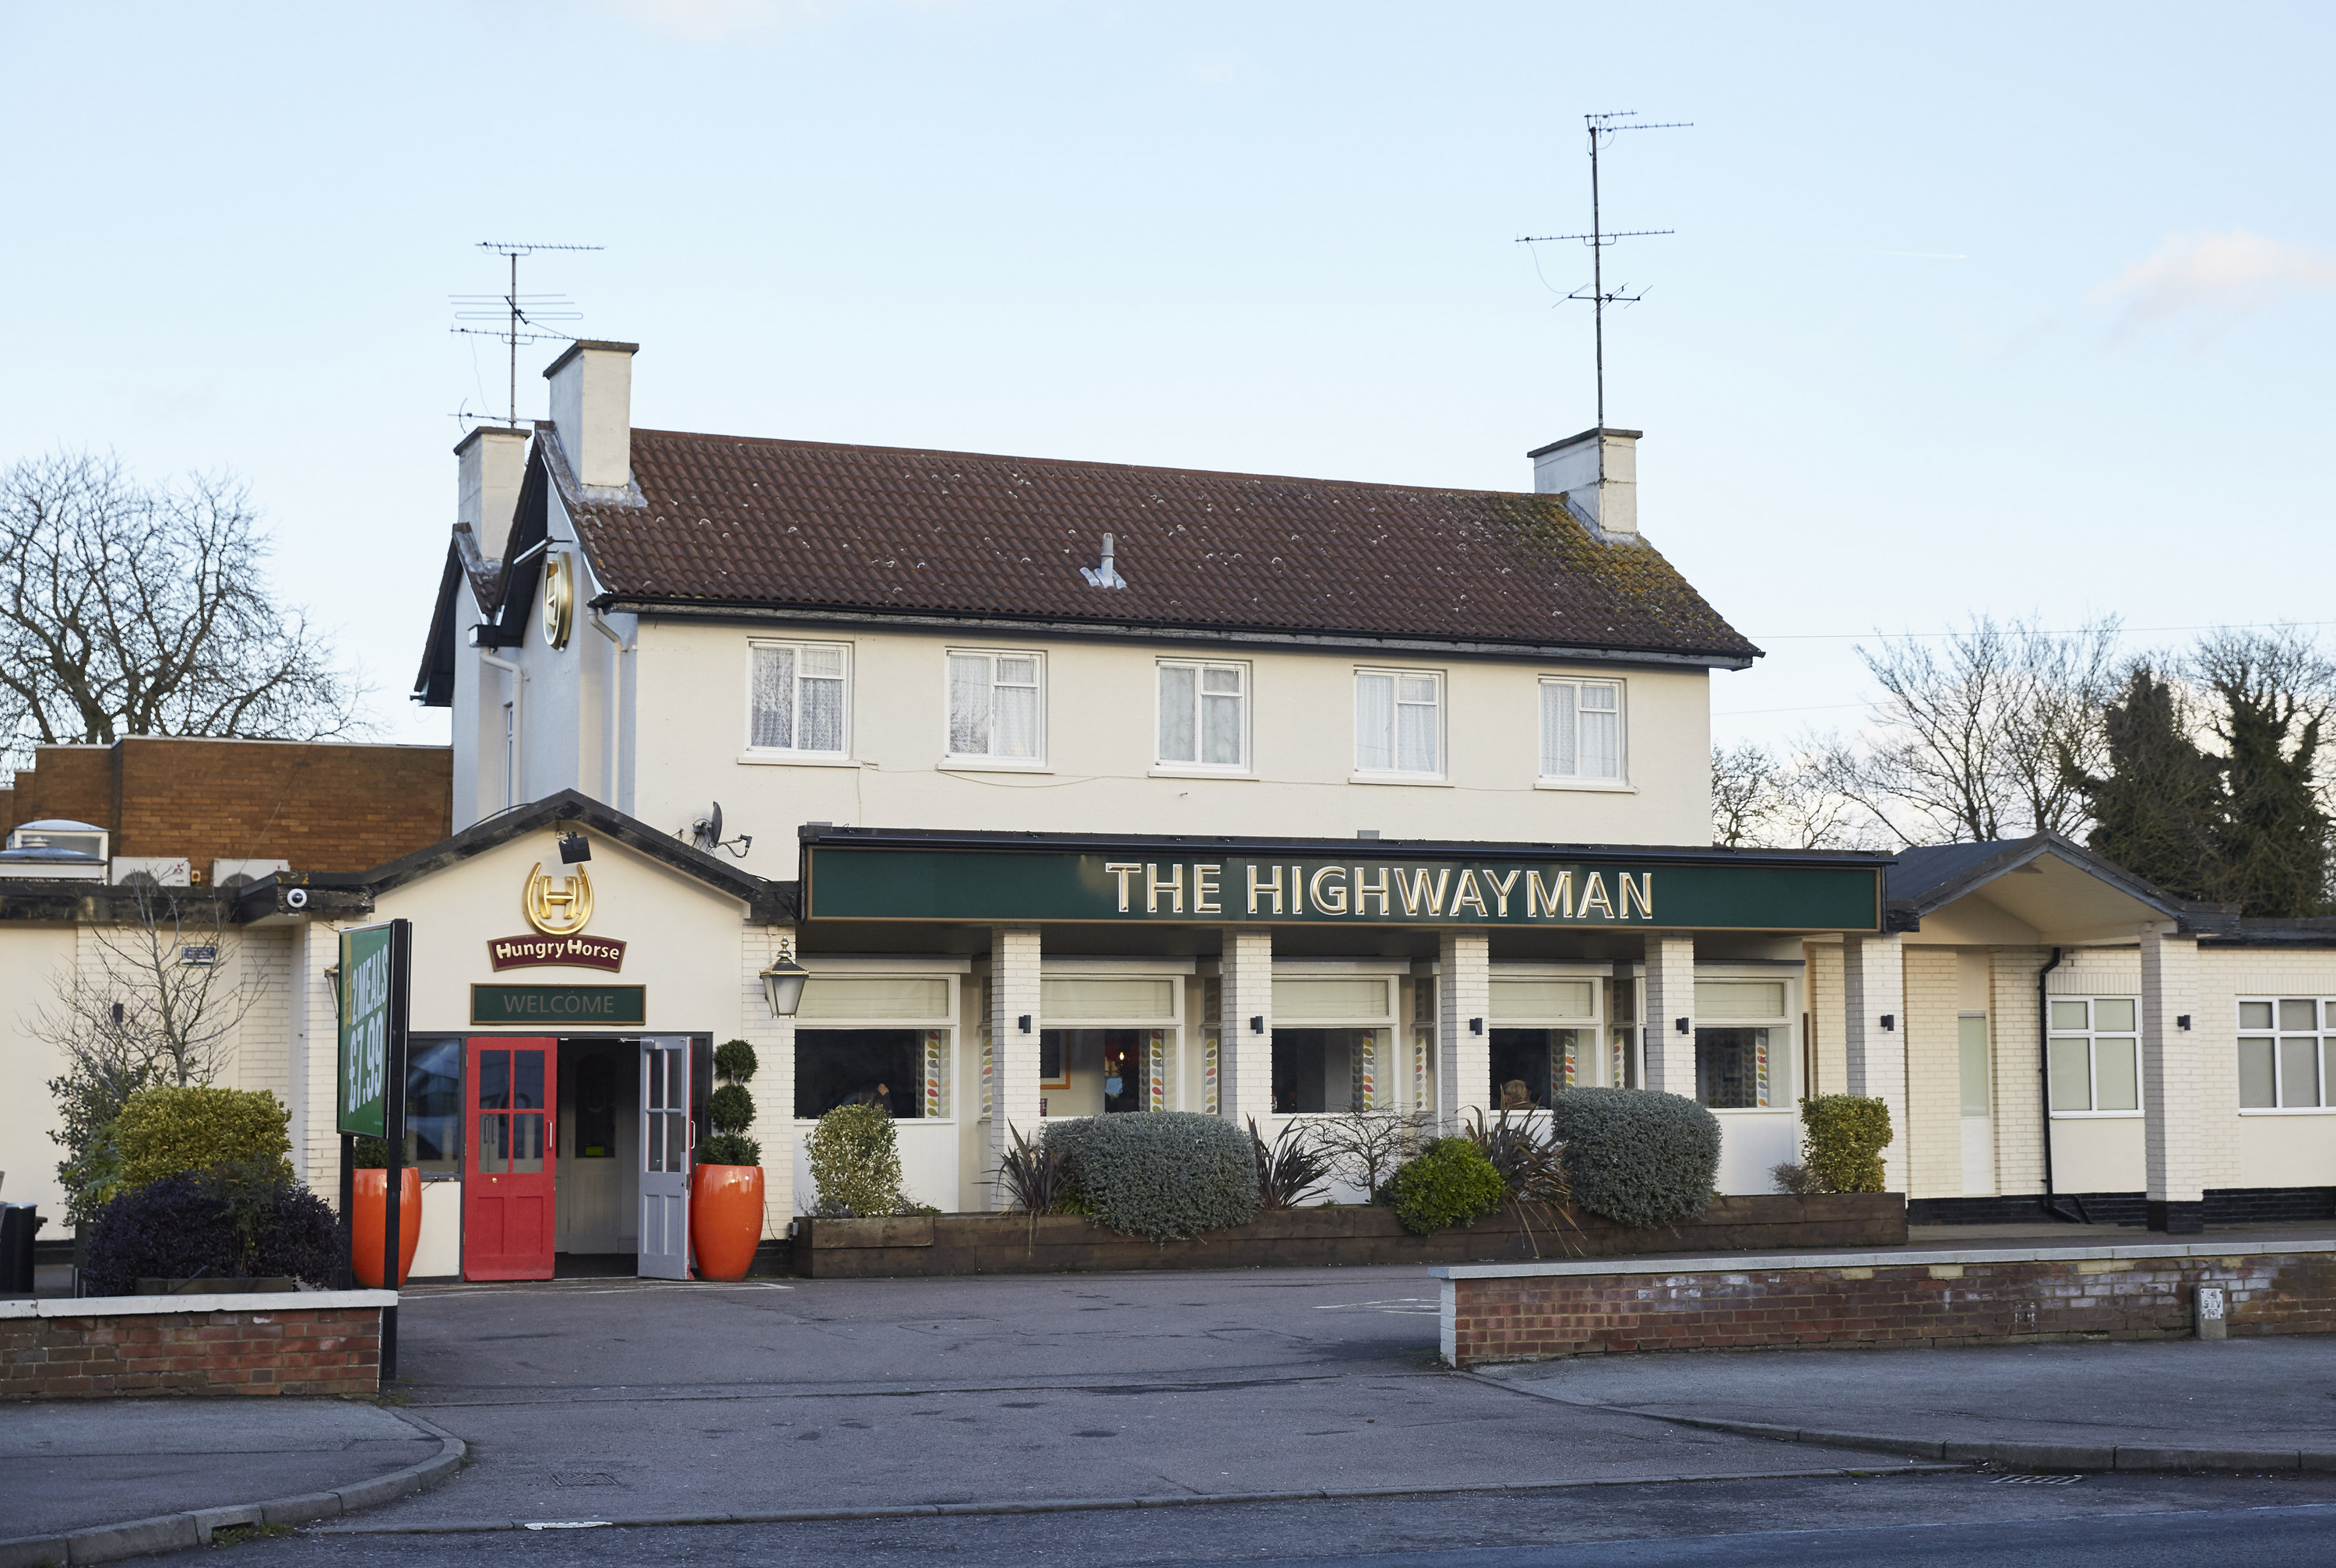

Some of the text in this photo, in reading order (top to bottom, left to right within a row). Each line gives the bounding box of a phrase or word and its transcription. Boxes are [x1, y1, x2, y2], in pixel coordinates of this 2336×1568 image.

[1106, 863, 1653, 919] THE HIGHWAYMAN
[495, 939, 620, 960] Hungry Horse
[352, 969, 357, 1026] 2
[358, 944, 388, 1021] MEALS
[504, 995, 614, 1014] WELCOME
[349, 1011, 383, 1113] £7.99
